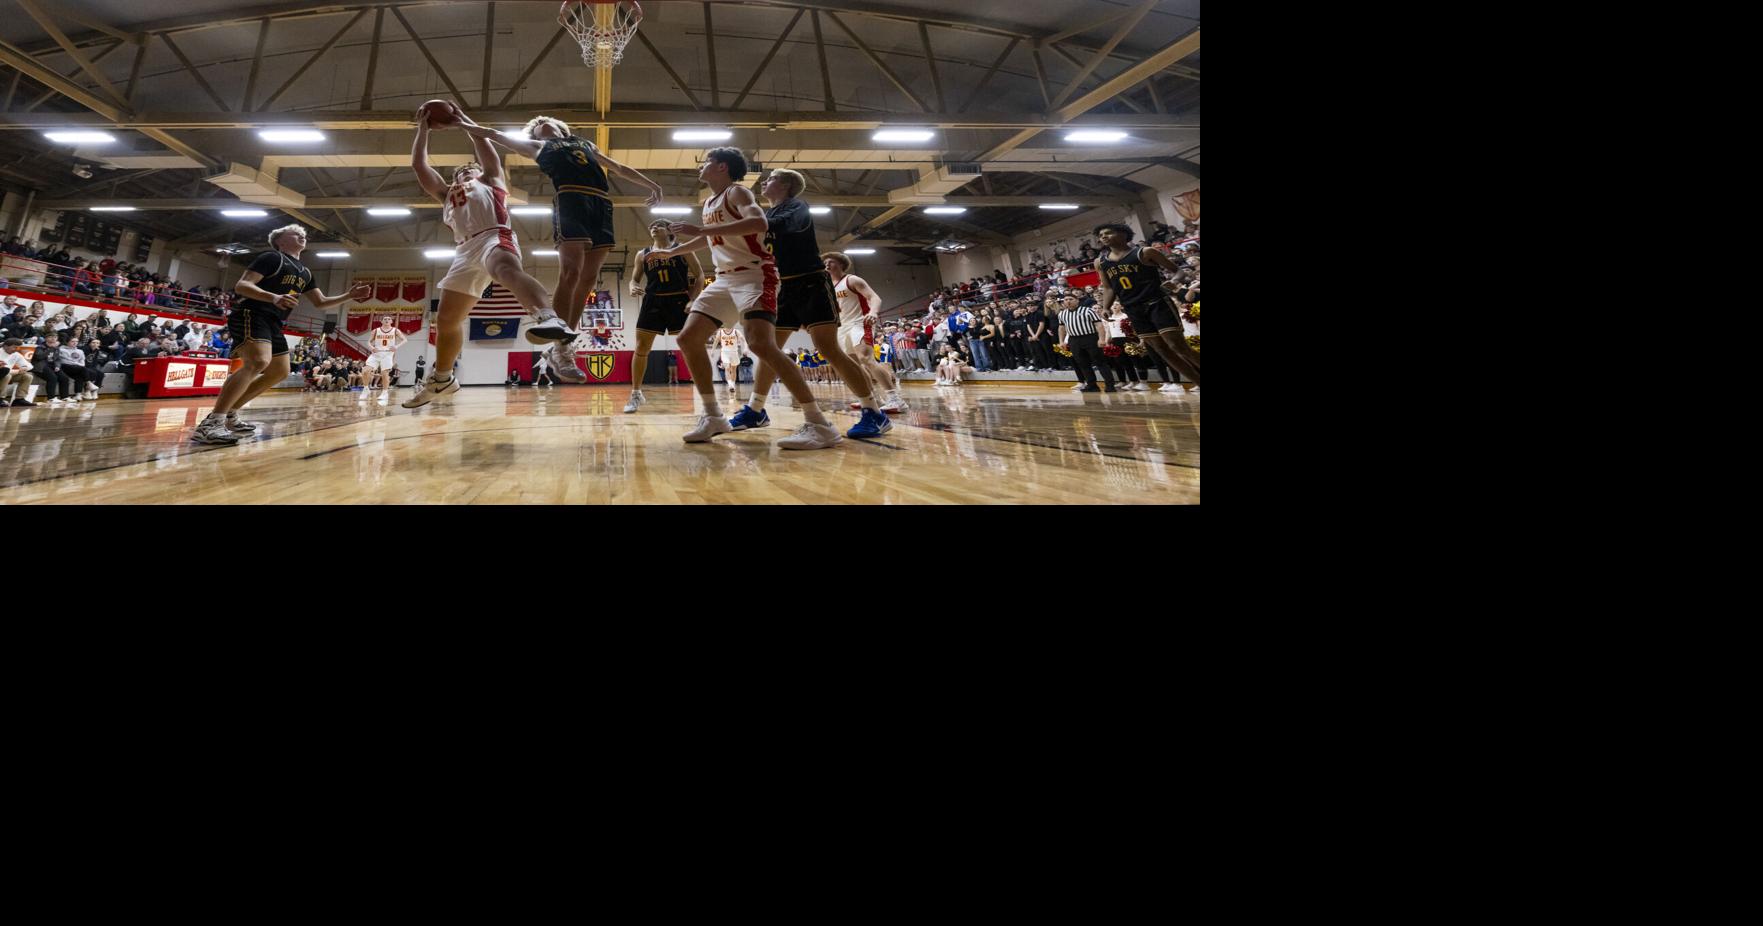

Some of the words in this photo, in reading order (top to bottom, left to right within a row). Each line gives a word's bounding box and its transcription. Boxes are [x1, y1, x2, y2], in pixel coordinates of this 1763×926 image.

[573, 150, 589, 165] 3
[450, 190, 467, 207] 13
[1117, 264, 1138, 272] SKY
[281, 275, 297, 284] BIG
[658, 269, 670, 283] 11
[1119, 276, 1133, 289] 0
[167, 367, 195, 382] HELLGATE
